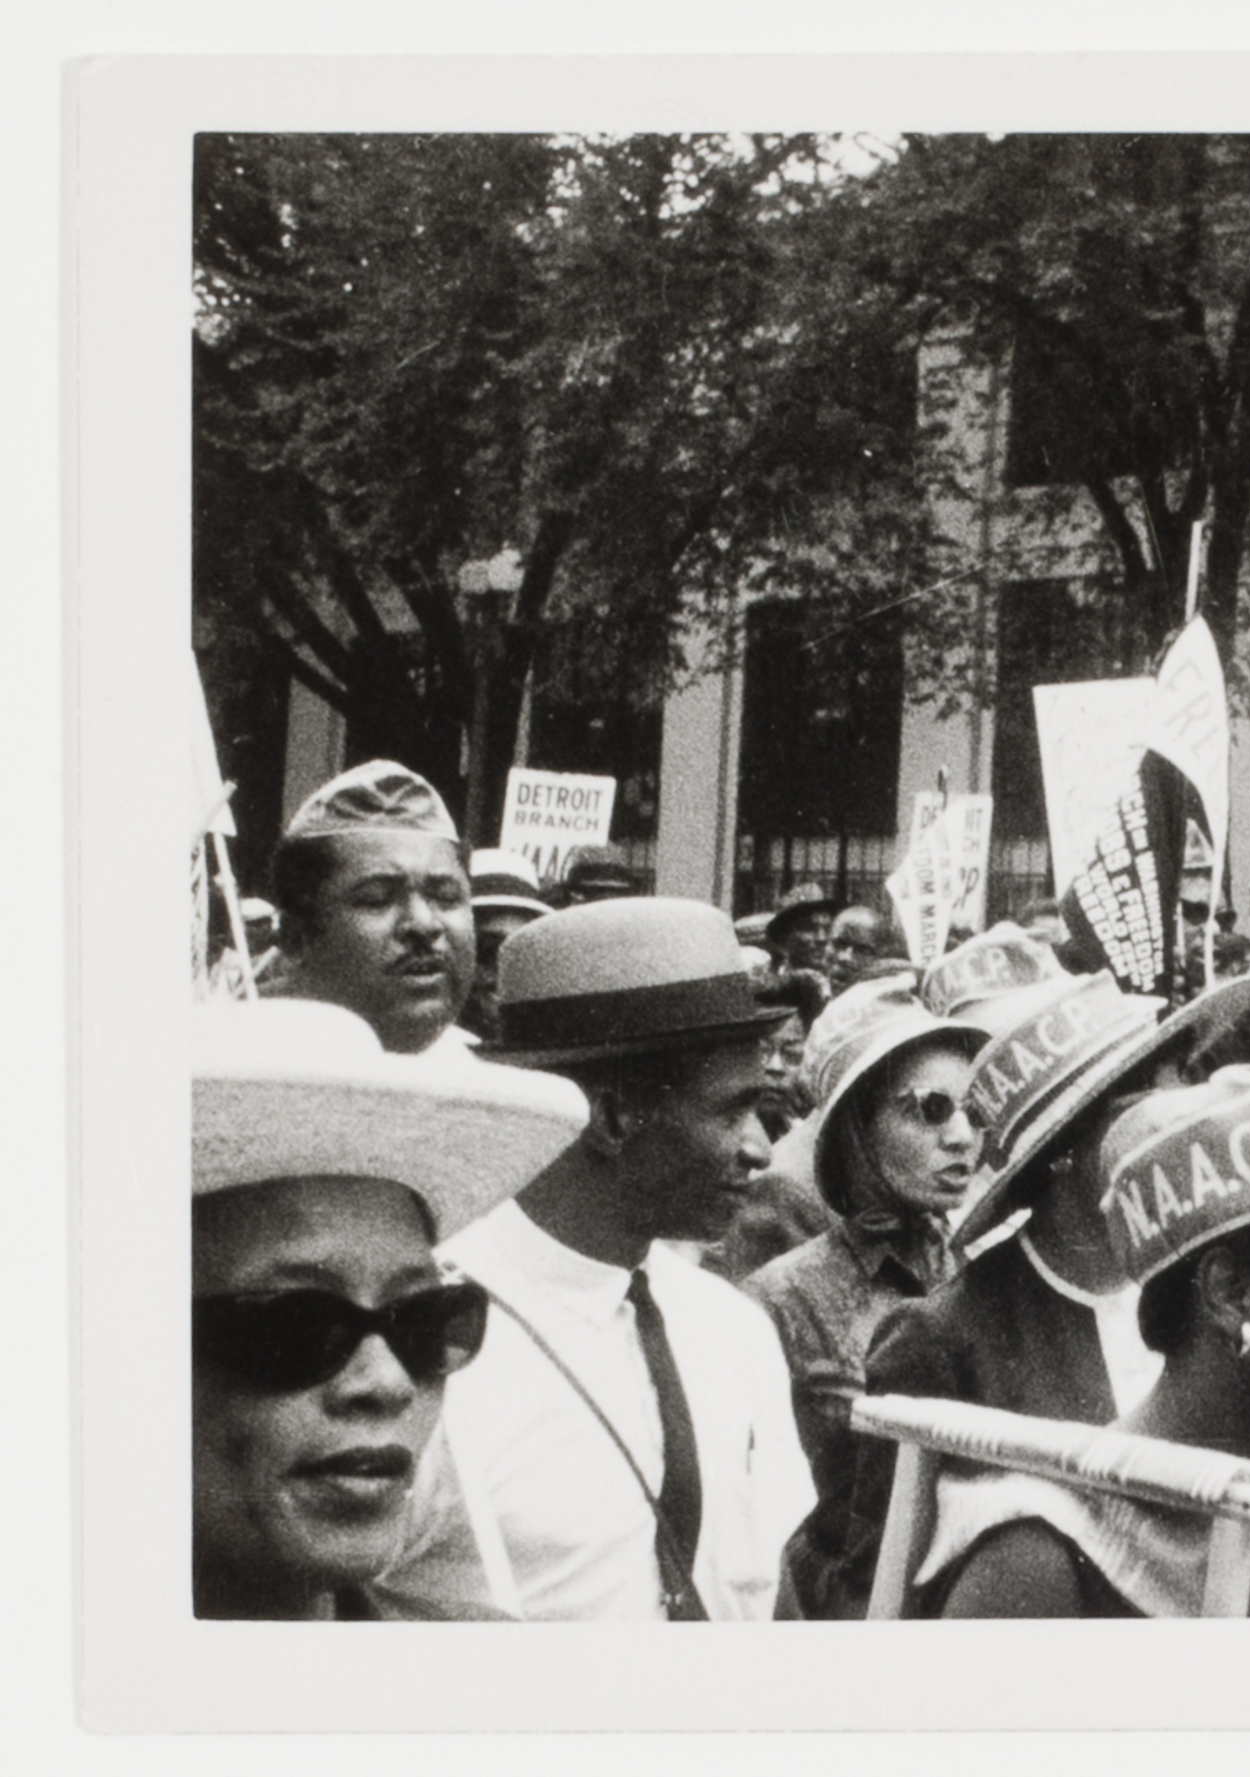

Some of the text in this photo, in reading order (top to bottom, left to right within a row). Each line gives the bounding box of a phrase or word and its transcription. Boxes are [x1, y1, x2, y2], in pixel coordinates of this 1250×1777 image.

[517, 782, 604, 812] DETROIT
[514, 810, 600, 831] BRANCH
[1117, 888, 1156, 993] FREEDOM
